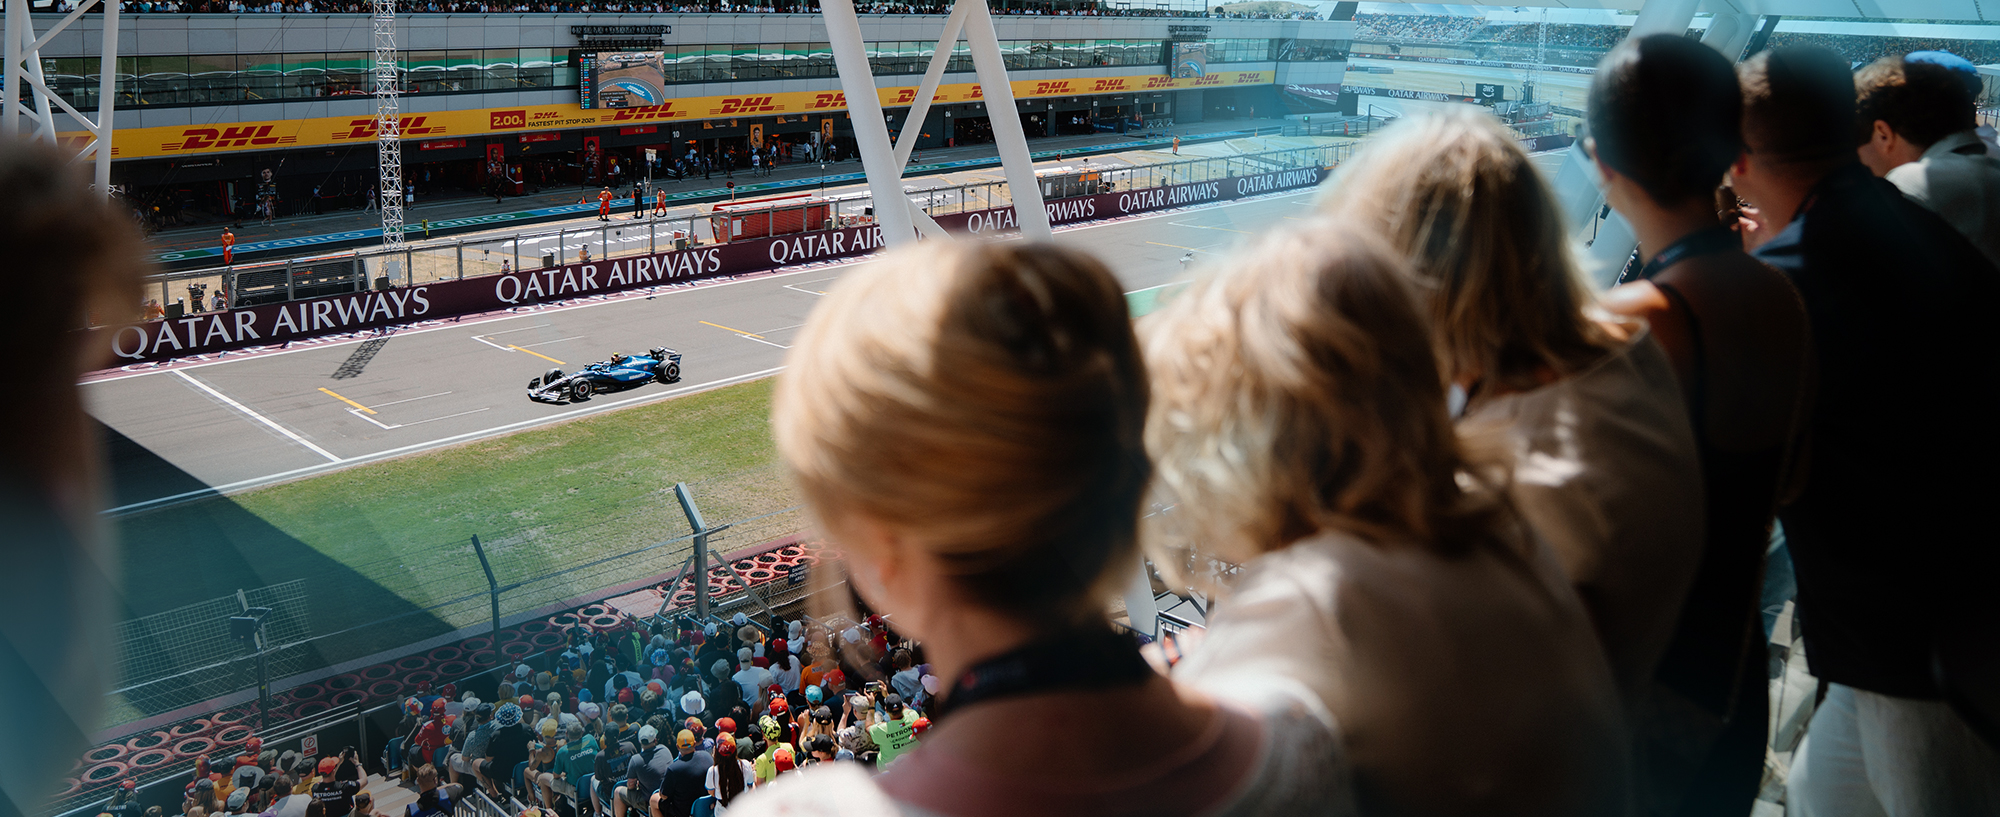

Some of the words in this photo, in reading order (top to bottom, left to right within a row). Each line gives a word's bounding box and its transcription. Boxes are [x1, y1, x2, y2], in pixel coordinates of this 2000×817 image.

[1094, 79, 1125, 91] DHL
[1147, 77, 1174, 88] DHL
[1194, 75, 1220, 85] DHL
[1238, 73, 1260, 83] DHL
[1036, 81, 1070, 94] DHL
[1388, 89, 1415, 98] QATAR
[1415, 91, 1449, 101] AIRWAYS
[613, 102, 676, 121] DHL
[720, 96, 775, 114] DHL
[348, 116, 431, 139] DHL
[493, 115, 523, 126] 2.00s
[181, 125, 280, 150] DHL
[672, 130, 680, 138] 10
[1237, 175, 1273, 195] QATAR
[1275, 168, 1317, 189] AIRWAYS
[1119, 189, 1164, 213] QATAR
[1167, 181, 1218, 205] AIRWAYS
[968, 209, 1020, 235] QATA
[1045, 198, 1095, 222] RWAYS
[232, 230, 365, 252] aramco
[769, 232, 845, 264] QATAR
[496, 264, 599, 304] QATAR
[607, 249, 721, 288] AIRWAYS
[112, 310, 261, 359] QATAR
[272, 287, 430, 337] AIRWAYS
[886, 726, 912, 738] PETRON
[570, 748, 593, 761] aramco
